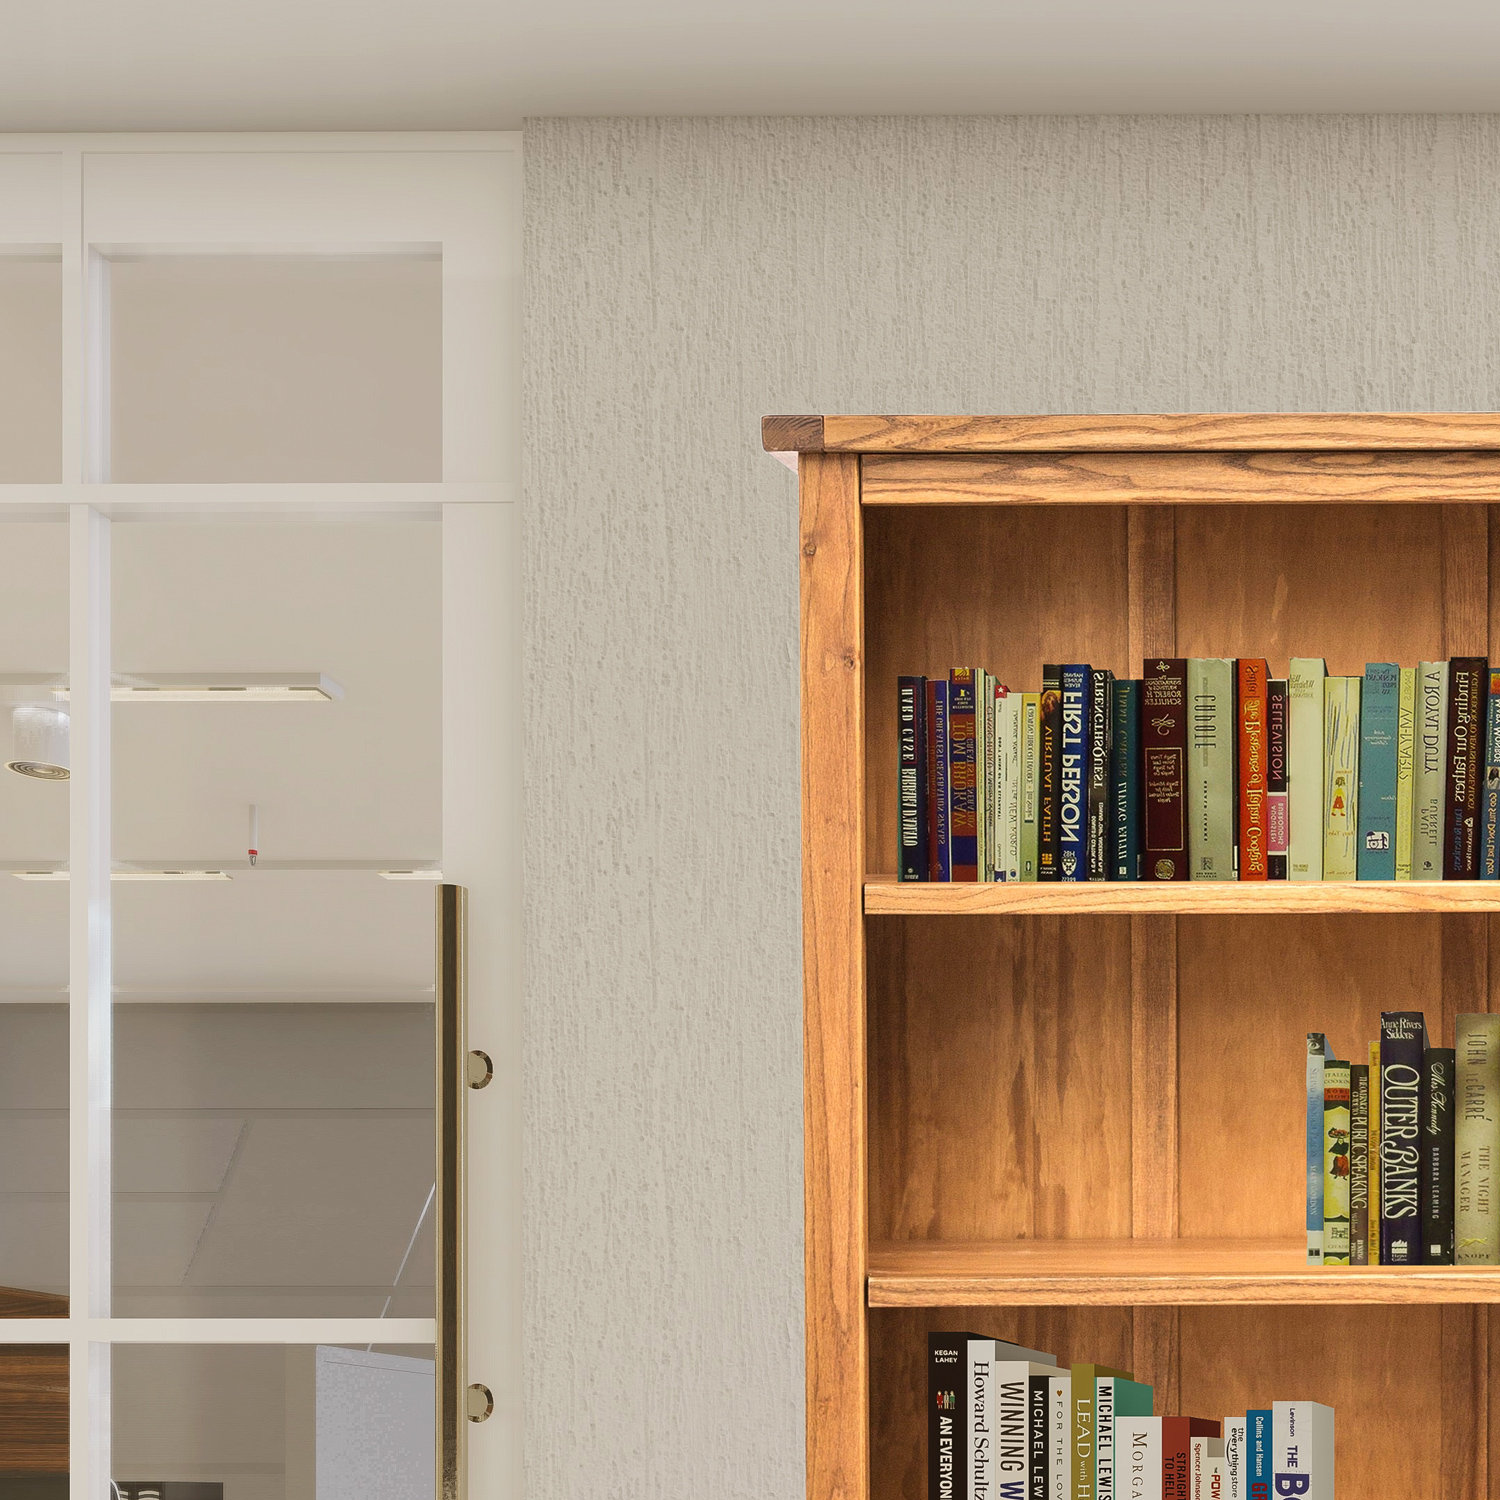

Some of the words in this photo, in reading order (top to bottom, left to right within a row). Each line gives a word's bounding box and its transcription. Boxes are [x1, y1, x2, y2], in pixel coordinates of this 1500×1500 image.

[1384, 1064, 1420, 1138] OUTER
[1351, 1116, 1367, 1154] PUBLIC
[1432, 1147, 1440, 1182] BARBARA
[1478, 1146, 1490, 1170] THE
[1350, 1154, 1368, 1209] SPEAKING
[1379, 1141, 1420, 1219] BANKS
[1460, 1150, 1472, 1212] MANAGER
[1477, 1176, 1490, 1215] NIGHT
[1432, 1184, 1440, 1219] LEAMING
[935, 1356, 958, 1364] LAHEY
[974, 1361, 990, 1434] Howard
[940, 1416, 952, 1432] AN
[1000, 1382, 1024, 1472] WINNING
[1033, 1390, 1044, 1459] MICHAEL
[1076, 1398, 1091, 1458] LEAD
[1098, 1386, 1112, 1451] MICHAEL
[1255, 1416, 1264, 1438] Collins
[1164, 1456, 1174, 1470] TO
[1255, 1440, 1264, 1452] and
[1287, 1445, 1298, 1468] THE
[1078, 1460, 1088, 1481] with
[1255, 1454, 1264, 1476] Hansen
[1164, 1474, 1174, 1498] HELL
